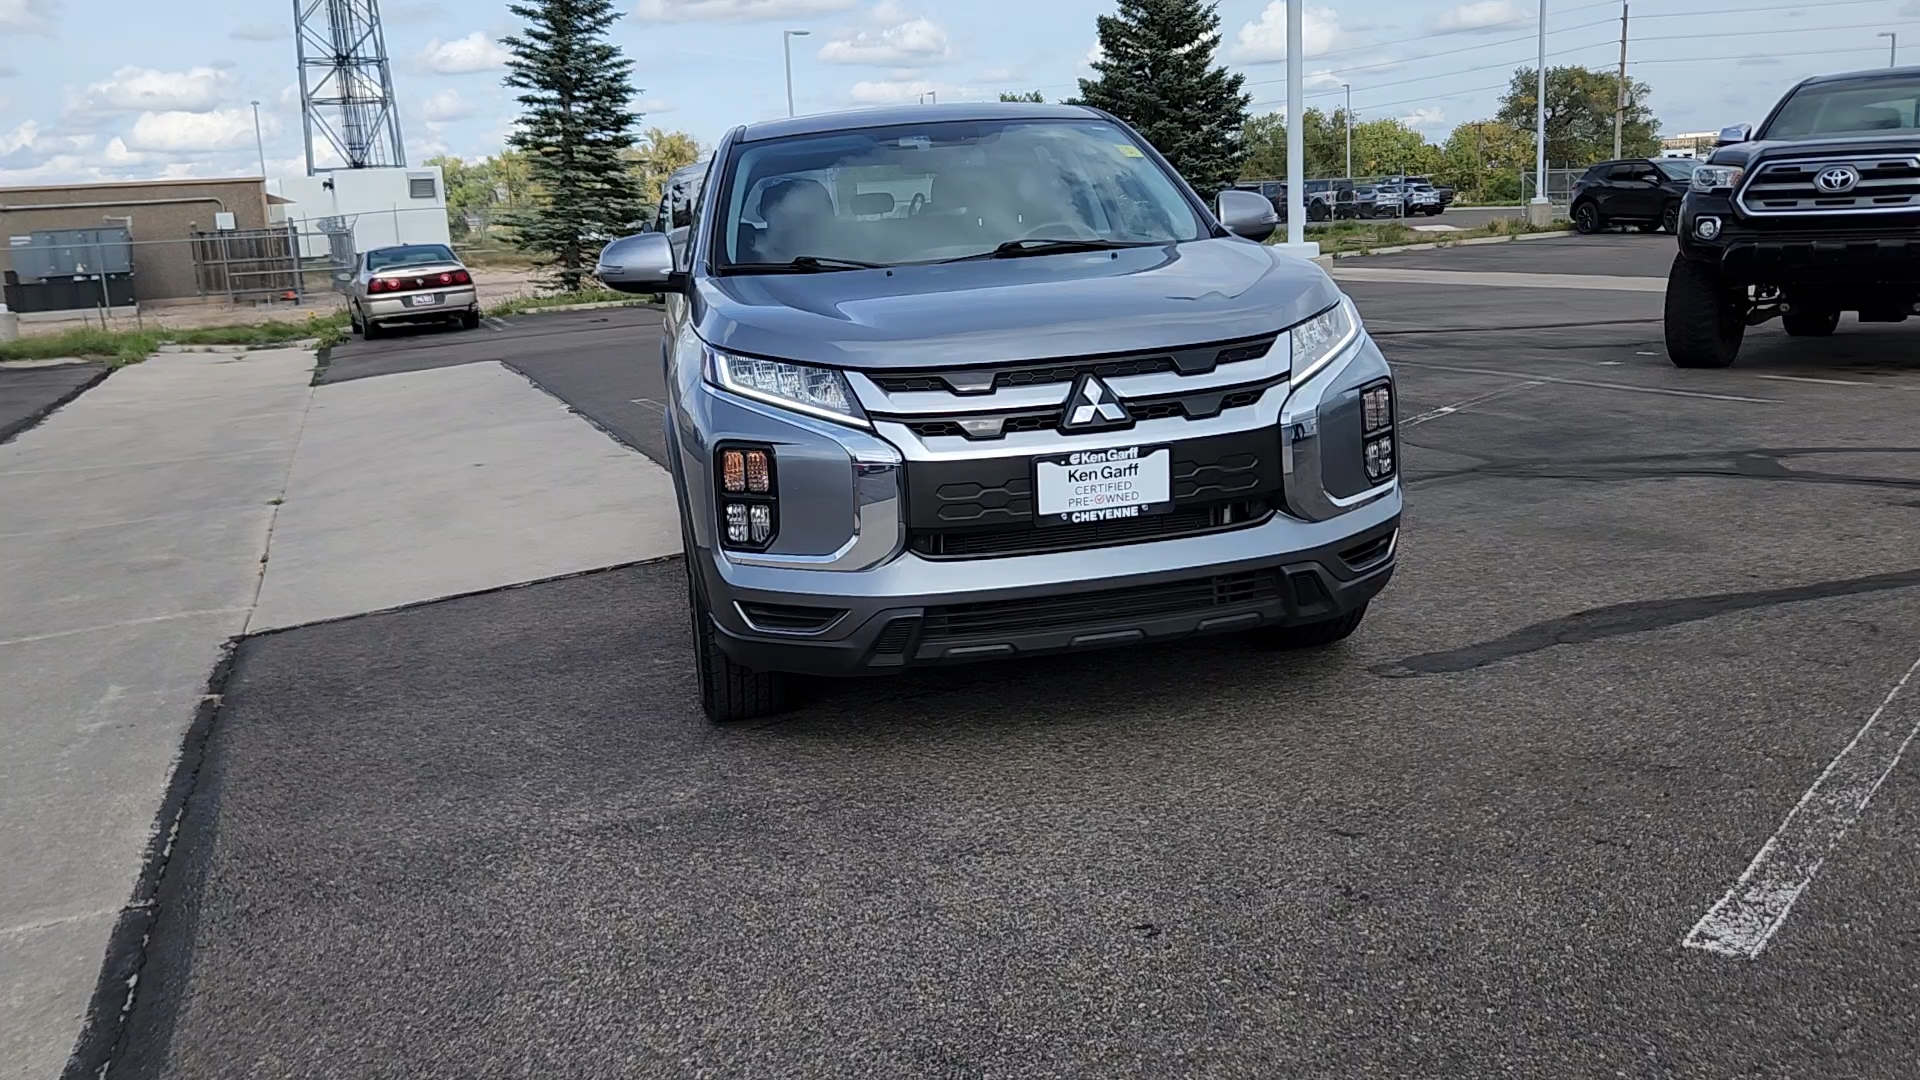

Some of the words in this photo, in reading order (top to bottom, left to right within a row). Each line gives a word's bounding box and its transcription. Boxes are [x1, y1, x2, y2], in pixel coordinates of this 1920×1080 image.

[1081, 451, 1106, 464] Ken
[1107, 446, 1139, 461] Garff
[1068, 468, 1098, 483] Ken
[1100, 463, 1139, 479] Garff
[1074, 481, 1132, 496] CERTIFIED
[1071, 506, 1139, 523] CHEYENNE
